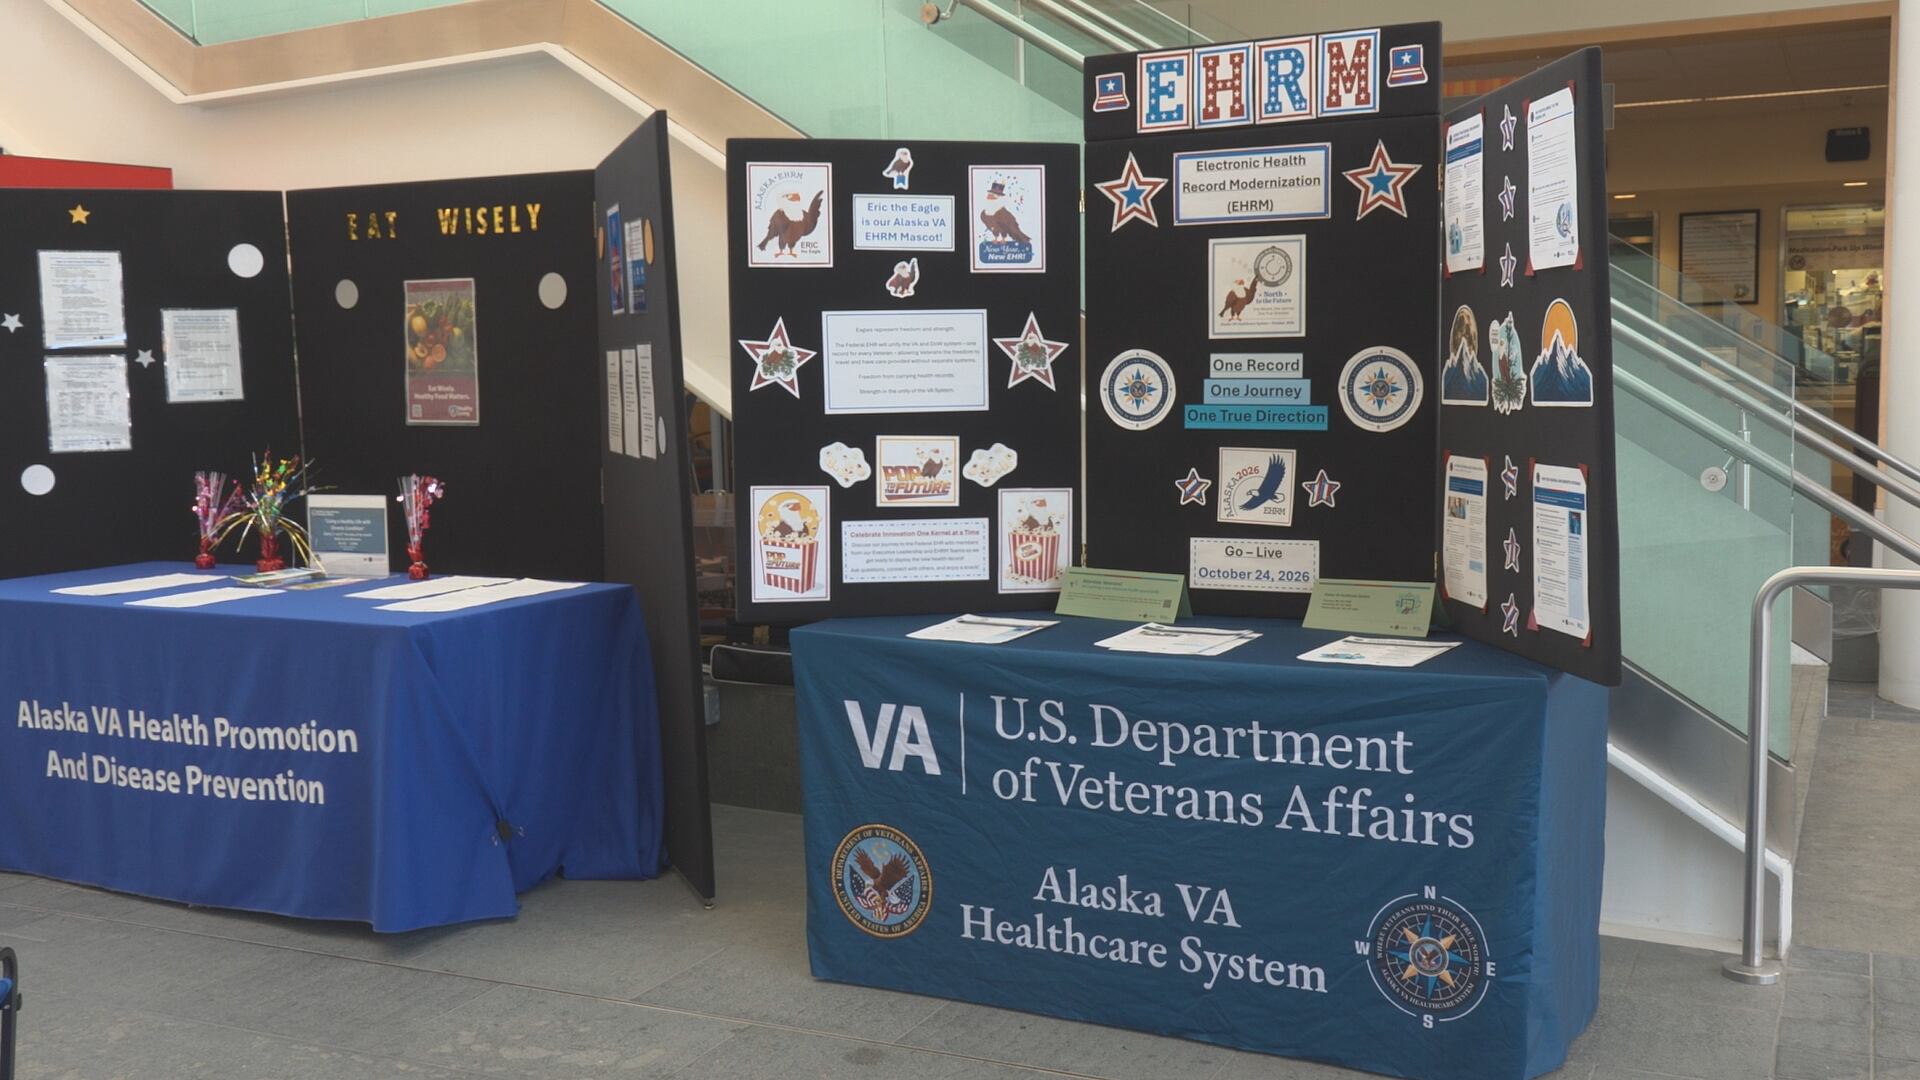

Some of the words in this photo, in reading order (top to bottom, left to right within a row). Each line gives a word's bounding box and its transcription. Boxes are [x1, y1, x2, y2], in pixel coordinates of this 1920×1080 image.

[1145, 38, 1372, 124] EHRM
[1196, 158, 1259, 172] Electronic
[1263, 155, 1306, 169] Health
[1182, 180, 1226, 193] Record
[1229, 175, 1321, 191] Modernization
[867, 203, 889, 212] Eric
[891, 203, 908, 212] the
[911, 203, 940, 214] Eagle
[1227, 200, 1274, 215] (EHRM)
[347, 211, 397, 240] EAT
[437, 203, 541, 235] WISELY
[862, 217, 870, 226] is
[893, 217, 930, 227] Alaska
[932, 218, 946, 227] VA
[865, 232, 898, 241] EHRM
[900, 232, 943, 242] Mascot!
[1213, 359, 1242, 372] One
[1247, 359, 1299, 372] Record
[1210, 385, 1240, 397] One
[1243, 385, 1302, 400] Journey
[1187, 410, 1217, 422] One
[1220, 409, 1252, 422] True
[1255, 409, 1326, 423] Direction
[882, 466, 921, 481] POP
[895, 480, 951, 494] FUTURE
[1224, 477, 1239, 517] ALASKA
[1236, 466, 1260, 480] 2026
[1263, 506, 1286, 515] EHRM
[1225, 546, 1244, 559] Go
[1256, 546, 1283, 559] Live
[1198, 567, 1252, 581] October
[1255, 568, 1274, 583] 24,
[1278, 569, 1311, 583] 2026
[17, 701, 89, 733] Alaska
[91, 706, 123, 737] VA
[128, 709, 209, 746] Health
[214, 717, 358, 753] Promotion
[991, 695, 1076, 745] U.S.
[1090, 704, 1413, 775] Department
[844, 700, 942, 776] VA
[47, 750, 88, 781] And
[92, 754, 181, 794] Disease
[185, 765, 324, 805] Prevention
[992, 757, 1041, 801] of
[1045, 763, 1264, 826] Veterans
[1276, 784, 1475, 849] Affairs
[836, 835, 862, 880] DEPARTMENT
[875, 830, 914, 854] VETERANS
[912, 855, 928, 892] AFFAIRS
[1033, 867, 1164, 918] Alaska
[1176, 883, 1242, 929] VA
[1424, 885, 1436, 900] N
[840, 890, 861, 921] UNITED
[861, 919, 890, 933] STATES
[891, 924, 902, 933] OF
[903, 901, 927, 928] AMERICA
[1376, 932, 1384, 960] WHERE
[1382, 905, 1416, 932] VETERANS
[1416, 904, 1436, 912] FIND
[1437, 907, 1461, 923] THEIR
[1460, 922, 1475, 941] TRUE
[960, 904, 1167, 970] Healthcare
[1180, 936, 1327, 994] System
[1354, 940, 1371, 956] W
[1486, 961, 1496, 977] E
[1382, 968, 1401, 994] ALASKA
[1400, 991, 1410, 1001] VA
[1409, 995, 1456, 1010] HEALTHCARE
[1455, 983, 1475, 1004] SYSTEM
[1422, 1014, 1434, 1029] S
